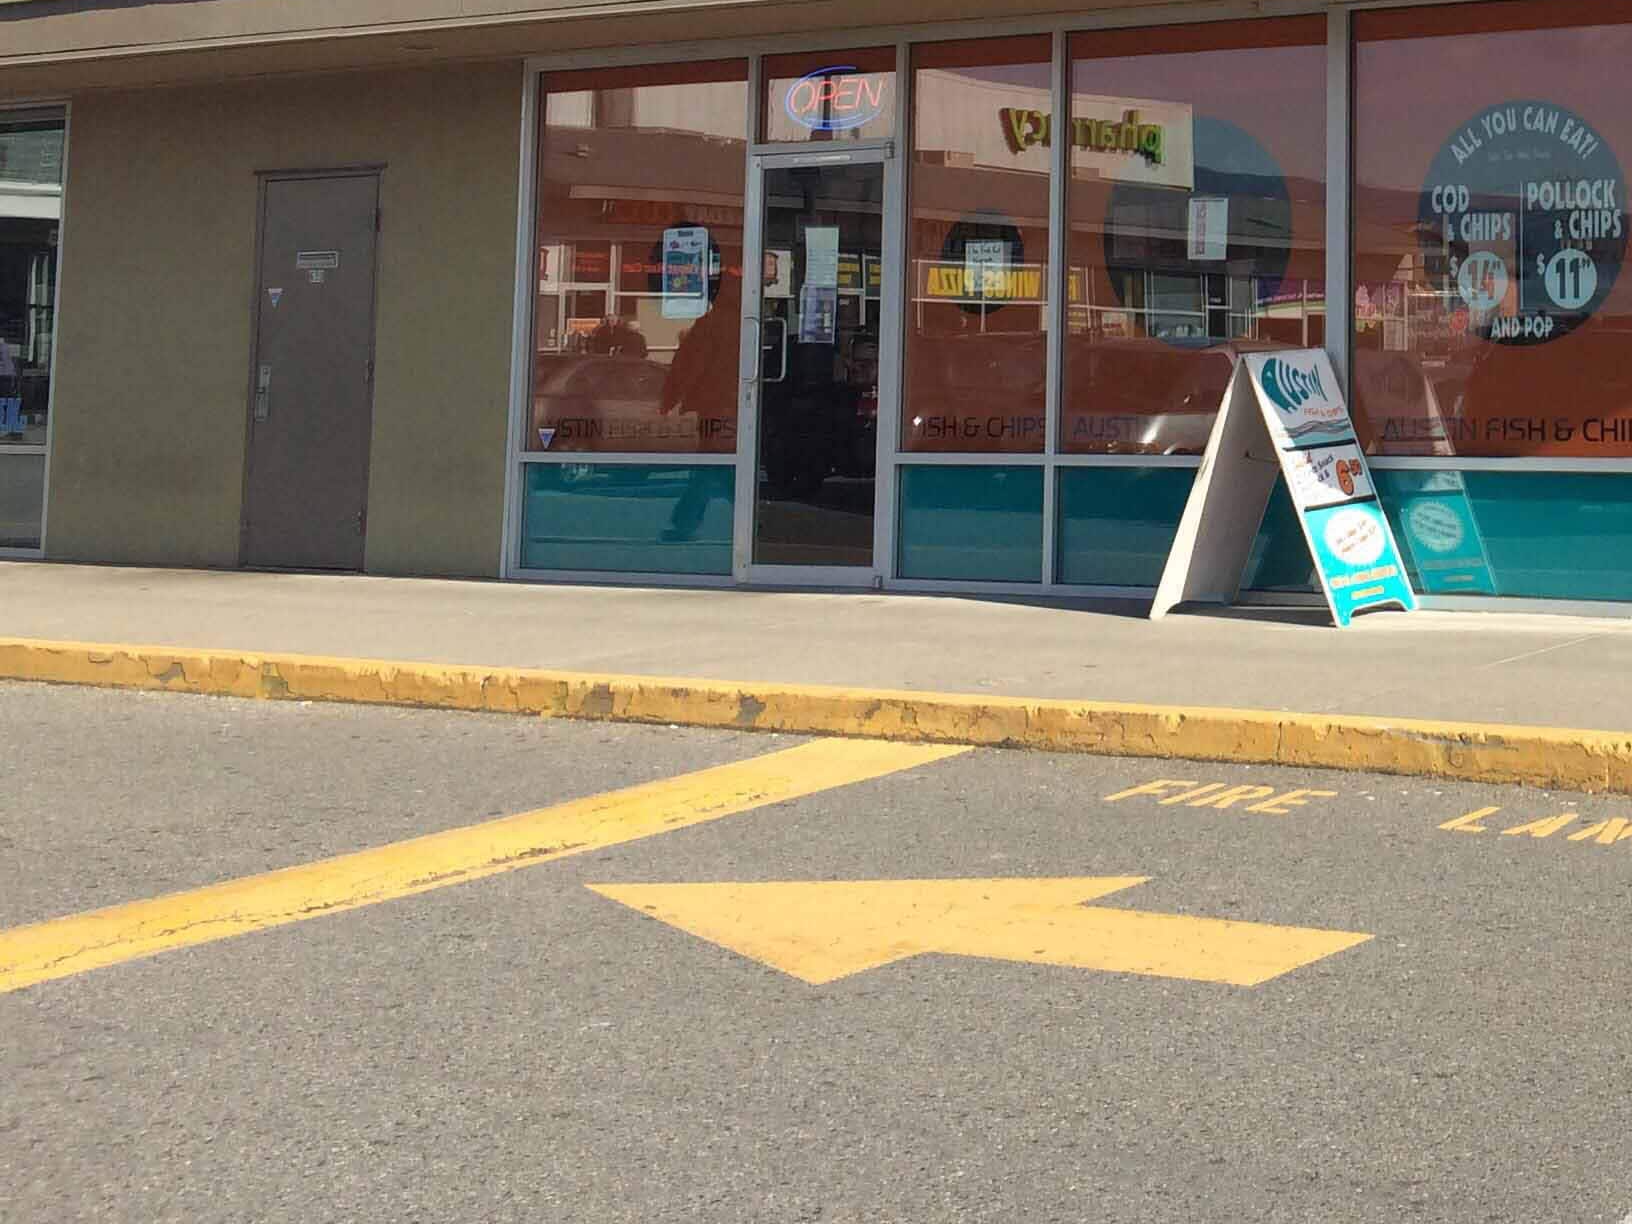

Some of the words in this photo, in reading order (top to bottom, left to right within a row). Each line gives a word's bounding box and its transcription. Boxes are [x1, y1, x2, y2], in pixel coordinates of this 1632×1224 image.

[789, 77, 887, 114] OPEN
[1451, 127, 1483, 167] ALL
[1481, 108, 1517, 140] YOU
[1523, 106, 1559, 135] CAN
[1559, 117, 1600, 161] EAT!
[1431, 184, 1470, 213] COD
[1527, 179, 1616, 211] POLLOCK
[1460, 212, 1512, 242] CHIPS
[1554, 220, 1563, 240] &
[1569, 209, 1623, 240] CHIPS
[1491, 317, 1520, 338] AND
[1524, 316, 1554, 337] POP
[1261, 358, 1328, 414] AUSTIN
[914, 416, 958, 439] ISH
[964, 417, 981, 439] &
[1384, 418, 1477, 441] AUSIN
[1486, 418, 1546, 442] FISH
[1555, 418, 1573, 441] &
[1104, 779, 1338, 814] FIRE
